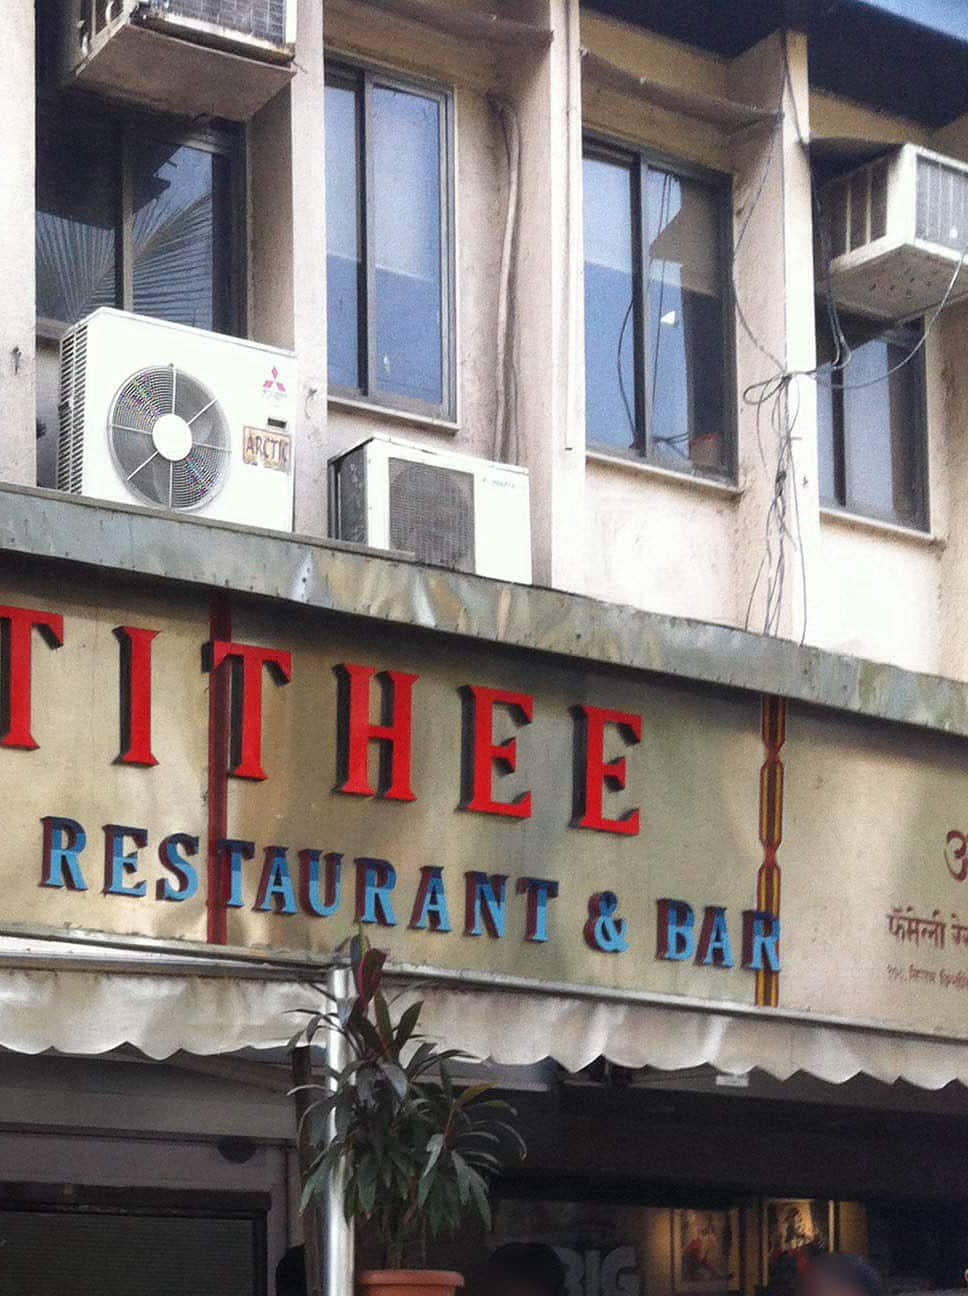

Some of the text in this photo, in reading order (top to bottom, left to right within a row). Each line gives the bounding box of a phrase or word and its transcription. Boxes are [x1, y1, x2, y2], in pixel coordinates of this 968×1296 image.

[41, 816, 559, 943] RESTAURANT
[585, 891, 629, 954] &
[657, 899, 780, 973] BAR
